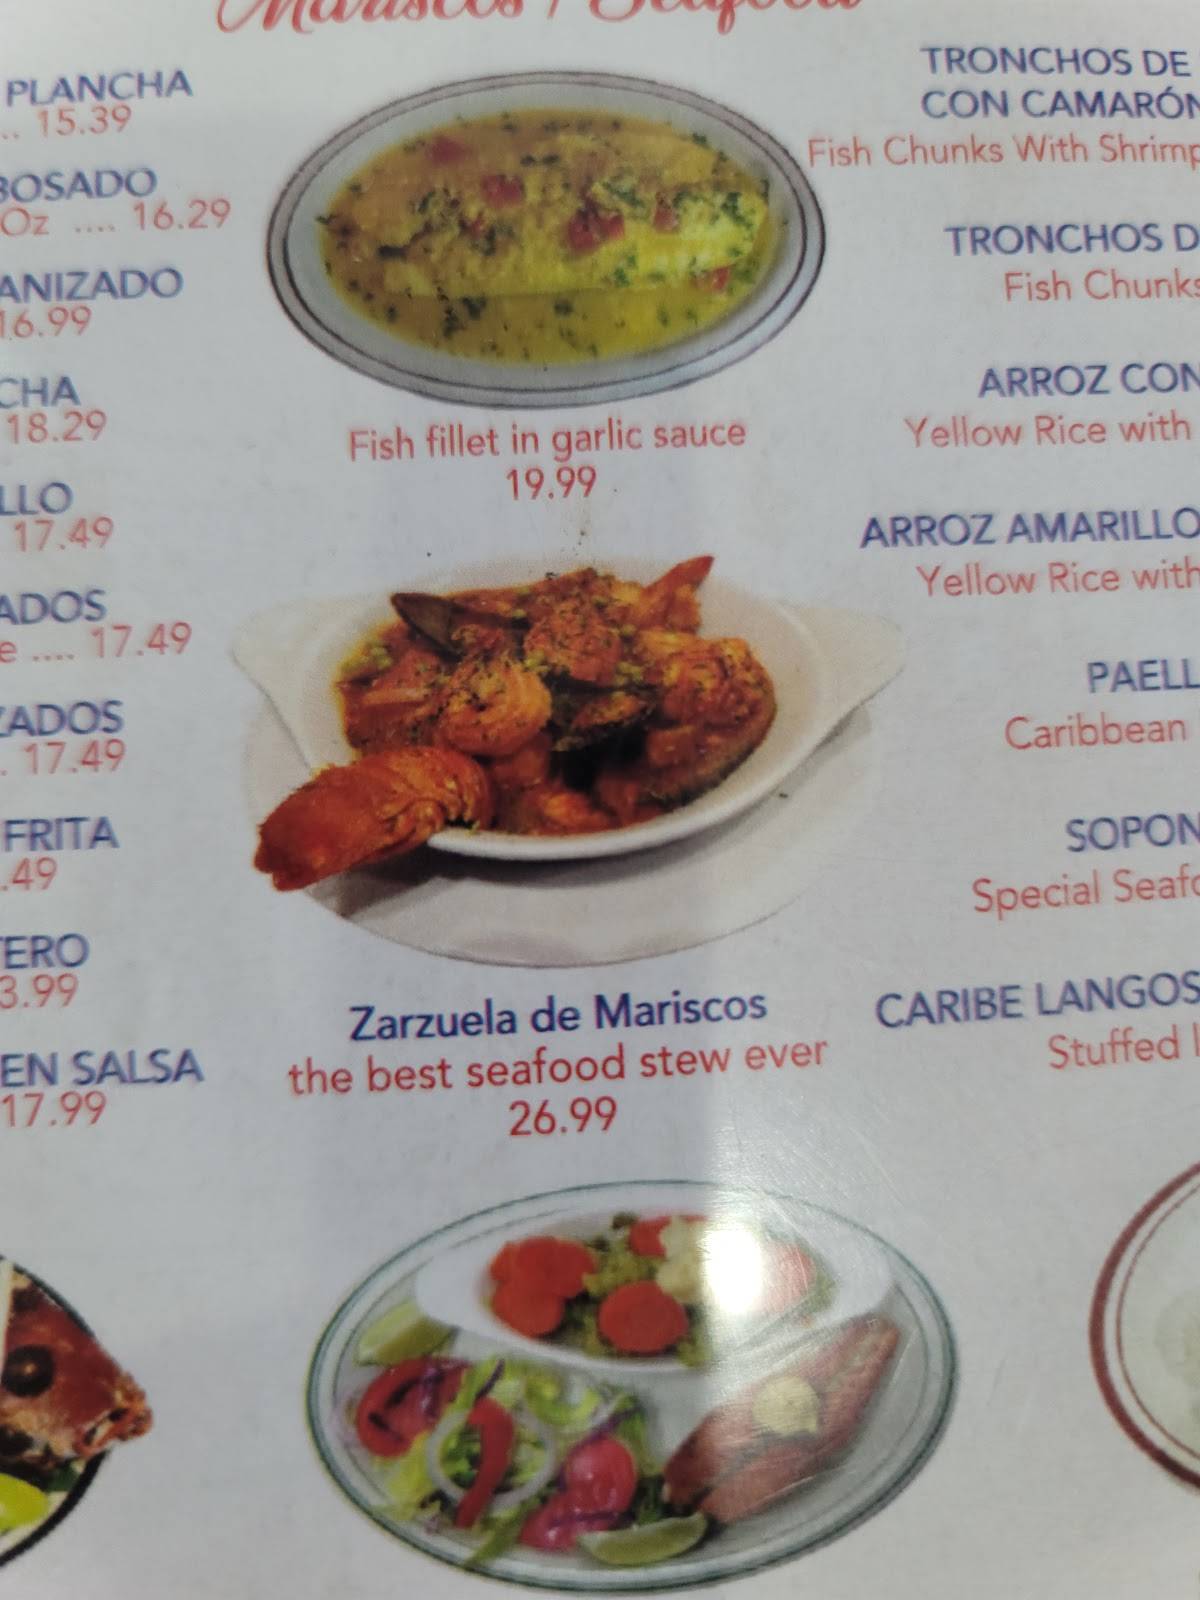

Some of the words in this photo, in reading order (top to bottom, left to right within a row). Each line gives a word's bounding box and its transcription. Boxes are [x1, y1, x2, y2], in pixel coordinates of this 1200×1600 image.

[920, 46, 1133, 76] TRONCHOS
[1142, 49, 1192, 77] DE
[6, 70, 193, 107] PLANCHA
[920, 89, 1009, 119] CON
[37, 104, 131, 137] 15.39
[807, 137, 871, 168] Fish
[883, 133, 1004, 165] Chunks
[1013, 134, 1089, 163] With
[0, 207, 50, 236] Oz
[133, 198, 231, 231] 16.29
[944, 224, 1163, 256] TRONCHOS
[0, 268, 183, 304] ANIZADO
[1004, 270, 1071, 302] Fish
[0, 305, 91, 338] 16.99
[0, 376, 81, 409] CHA
[978, 364, 1111, 398] ARROZ
[1120, 362, 1200, 394] CON
[7, 410, 107, 444] 18.29
[349, 427, 415, 462] Fish
[426, 423, 500, 458] fillet
[511, 424, 539, 455] in
[551, 417, 642, 463] garlic
[653, 420, 746, 448] sauce
[904, 415, 1023, 448] Yellow
[1035, 414, 1107, 445] Rice
[1118, 409, 1192, 443] with
[506, 465, 598, 501] 19.99
[14, 516, 113, 552] 17.49
[859, 514, 996, 549] ARROZ
[1006, 507, 1200, 544] AMARILLO
[916, 562, 1036, 597] Yellow
[1048, 562, 1121, 593] Rice
[1131, 556, 1200, 590] with
[0, 588, 107, 626] ADOS
[91, 622, 192, 658] 17.49
[0, 700, 124, 738] ADOS
[1004, 712, 1187, 750] Caribbean
[23, 738, 125, 776] 17.49
[5, 817, 120, 852] FRITA
[972, 868, 1101, 920] Special
[0, 933, 90, 970] ERO
[0, 973, 78, 1010] 3.99
[875, 984, 1024, 1030] CARIBE
[1035, 969, 1200, 1016] LANGOS
[349, 999, 518, 1043] Zarzuela
[530, 995, 581, 1032] de
[594, 990, 768, 1029] Mariscos
[1048, 1024, 1180, 1070] Stuffed
[1, 1053, 59, 1089] EN
[73, 1049, 204, 1087] SALSA
[288, 1056, 353, 1096] the
[367, 1055, 453, 1092] best
[466, 1042, 626, 1087] seafood
[639, 1043, 731, 1079] stew
[744, 1037, 828, 1071] ever
[3, 1092, 107, 1128] 17.99
[509, 1096, 618, 1136] 26.99
